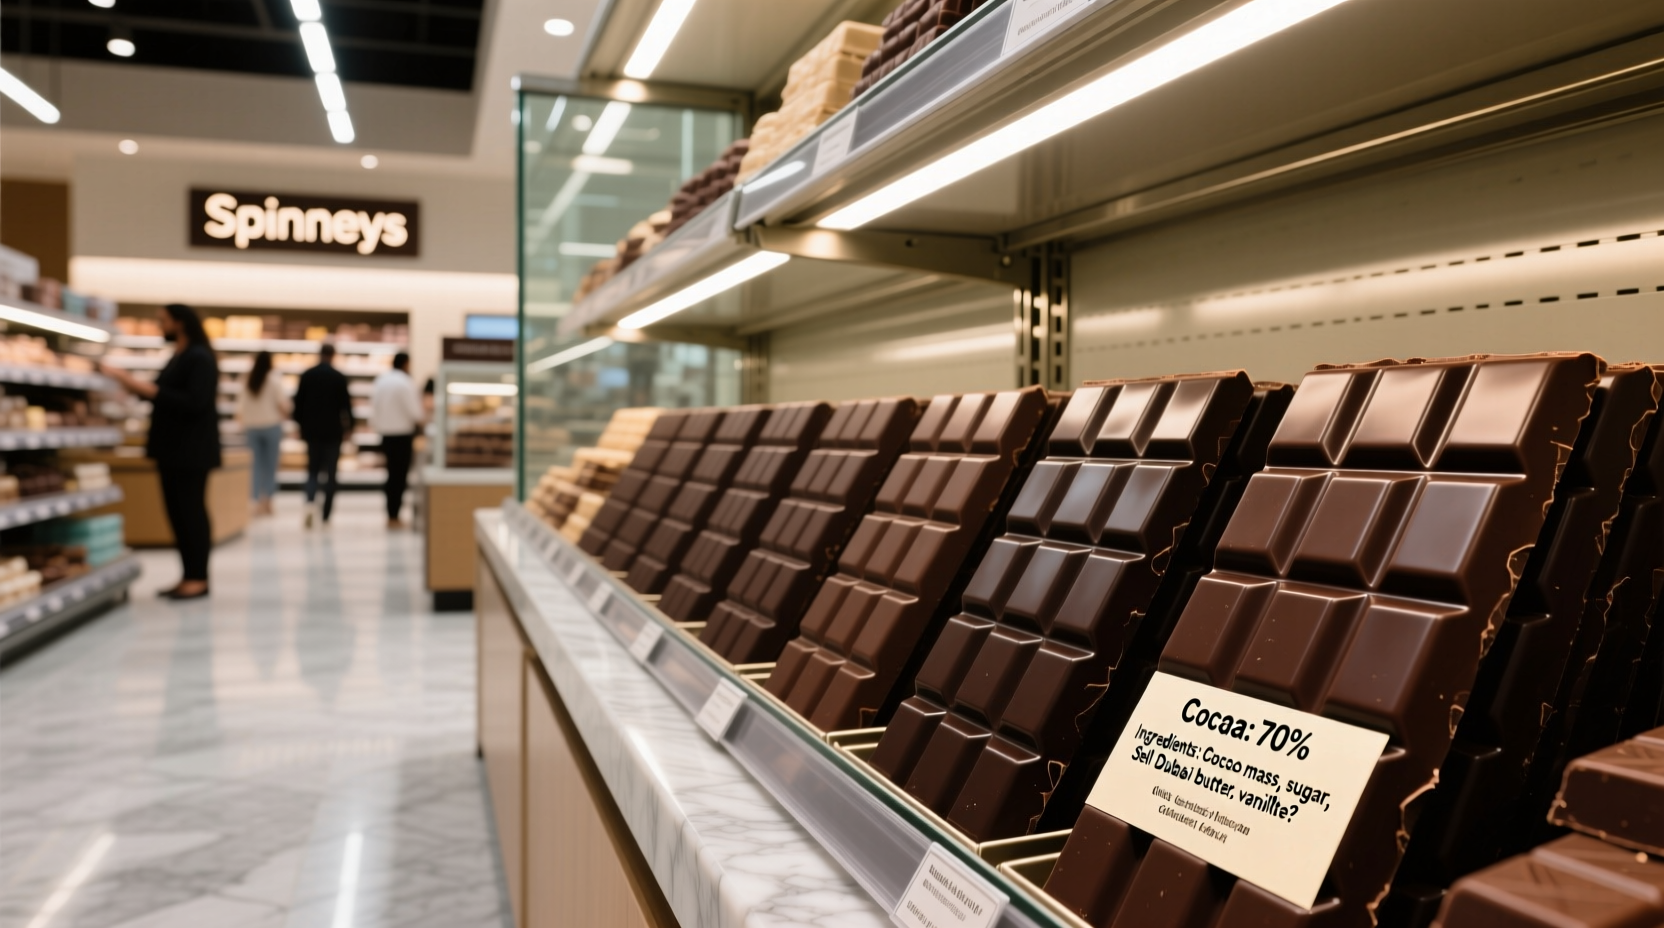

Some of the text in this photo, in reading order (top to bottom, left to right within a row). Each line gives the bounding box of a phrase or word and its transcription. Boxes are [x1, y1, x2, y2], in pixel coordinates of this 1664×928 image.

[204, 193, 408, 255] Spinneys
[1131, 745, 1155, 766] Sell
[1181, 698, 1313, 760] Cocaa: 70%
[1242, 764, 1281, 793] mass,
[1285, 779, 1331, 812] sugar,
